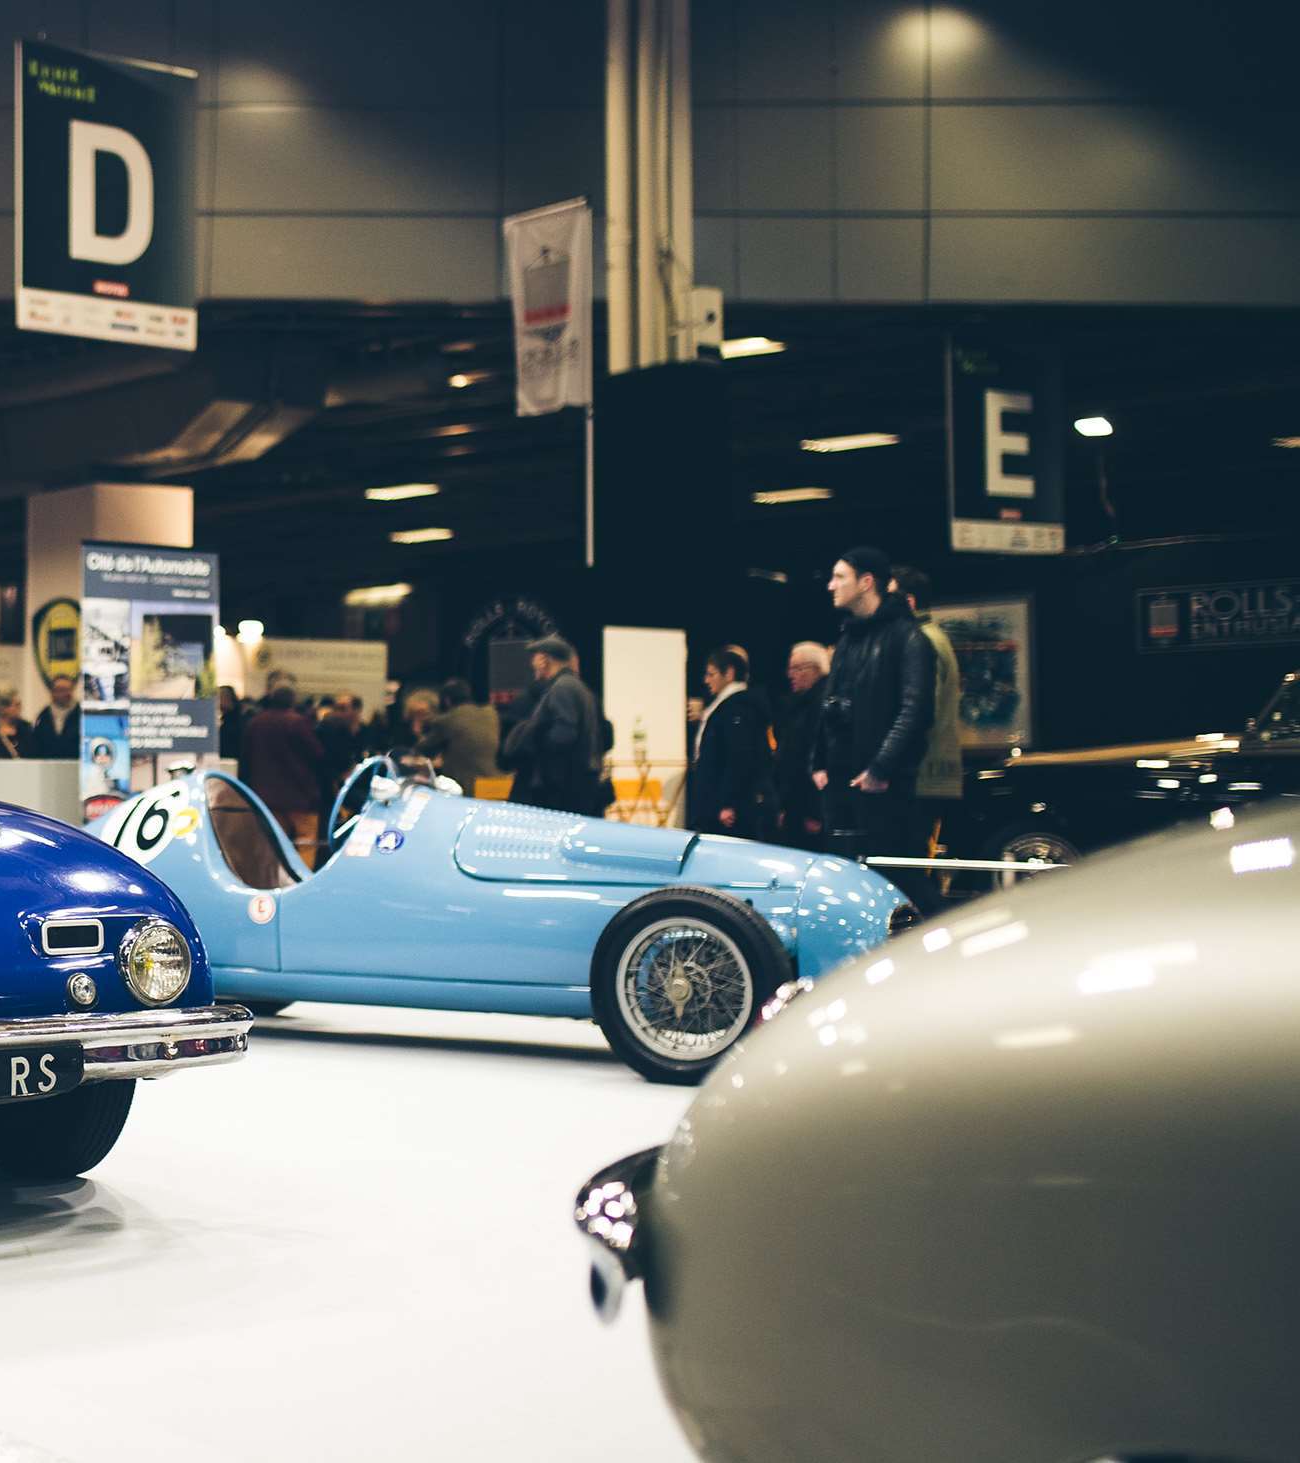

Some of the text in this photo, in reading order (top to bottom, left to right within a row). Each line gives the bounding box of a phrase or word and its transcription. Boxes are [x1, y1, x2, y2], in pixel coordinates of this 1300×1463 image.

[69, 119, 154, 265] D
[985, 389, 1035, 498] E
[113, 790, 180, 851] 16
[11, 1053, 57, 1097] RS
